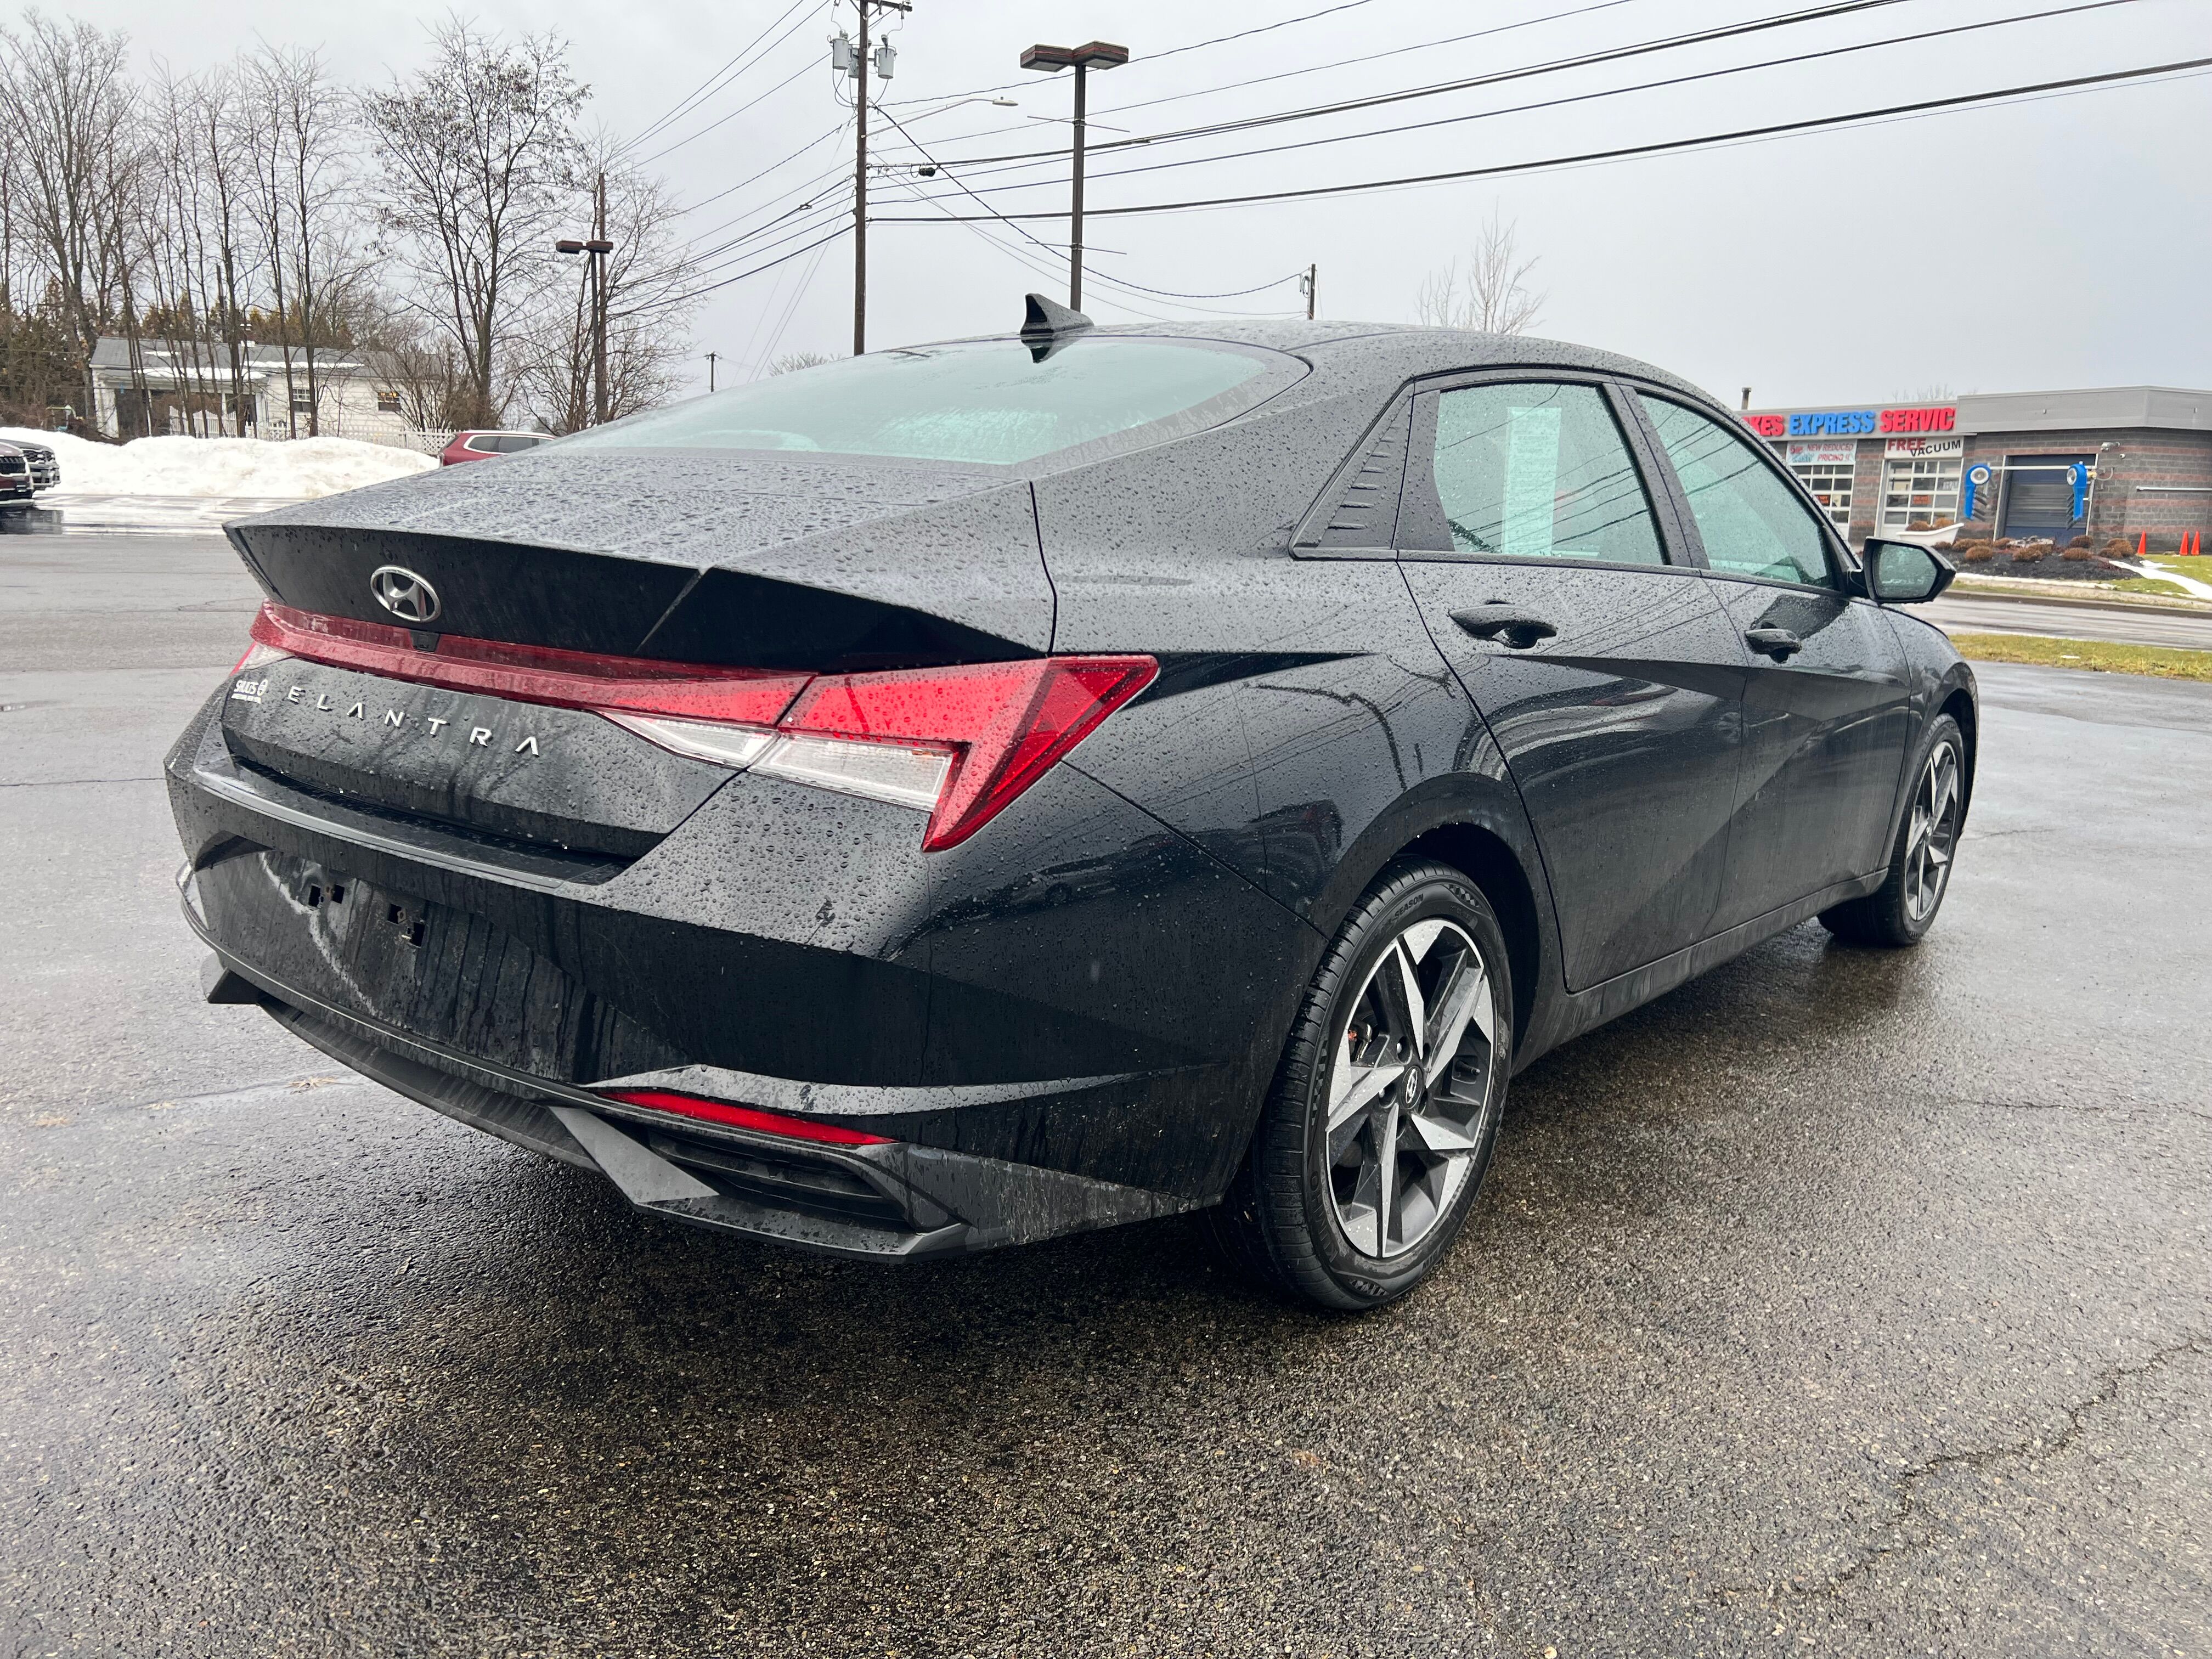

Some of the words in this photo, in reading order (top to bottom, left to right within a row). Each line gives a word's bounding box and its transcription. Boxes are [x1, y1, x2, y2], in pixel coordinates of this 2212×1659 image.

[1742, 415, 1784, 436] KES
[1789, 411, 1875, 435] EXPRESS
[1880, 408, 1956, 432] SERVIC
[1887, 438, 1927, 451] FREE
[1910, 439, 1961, 457] VACUUM
[286, 686, 540, 757] ELANTRA
